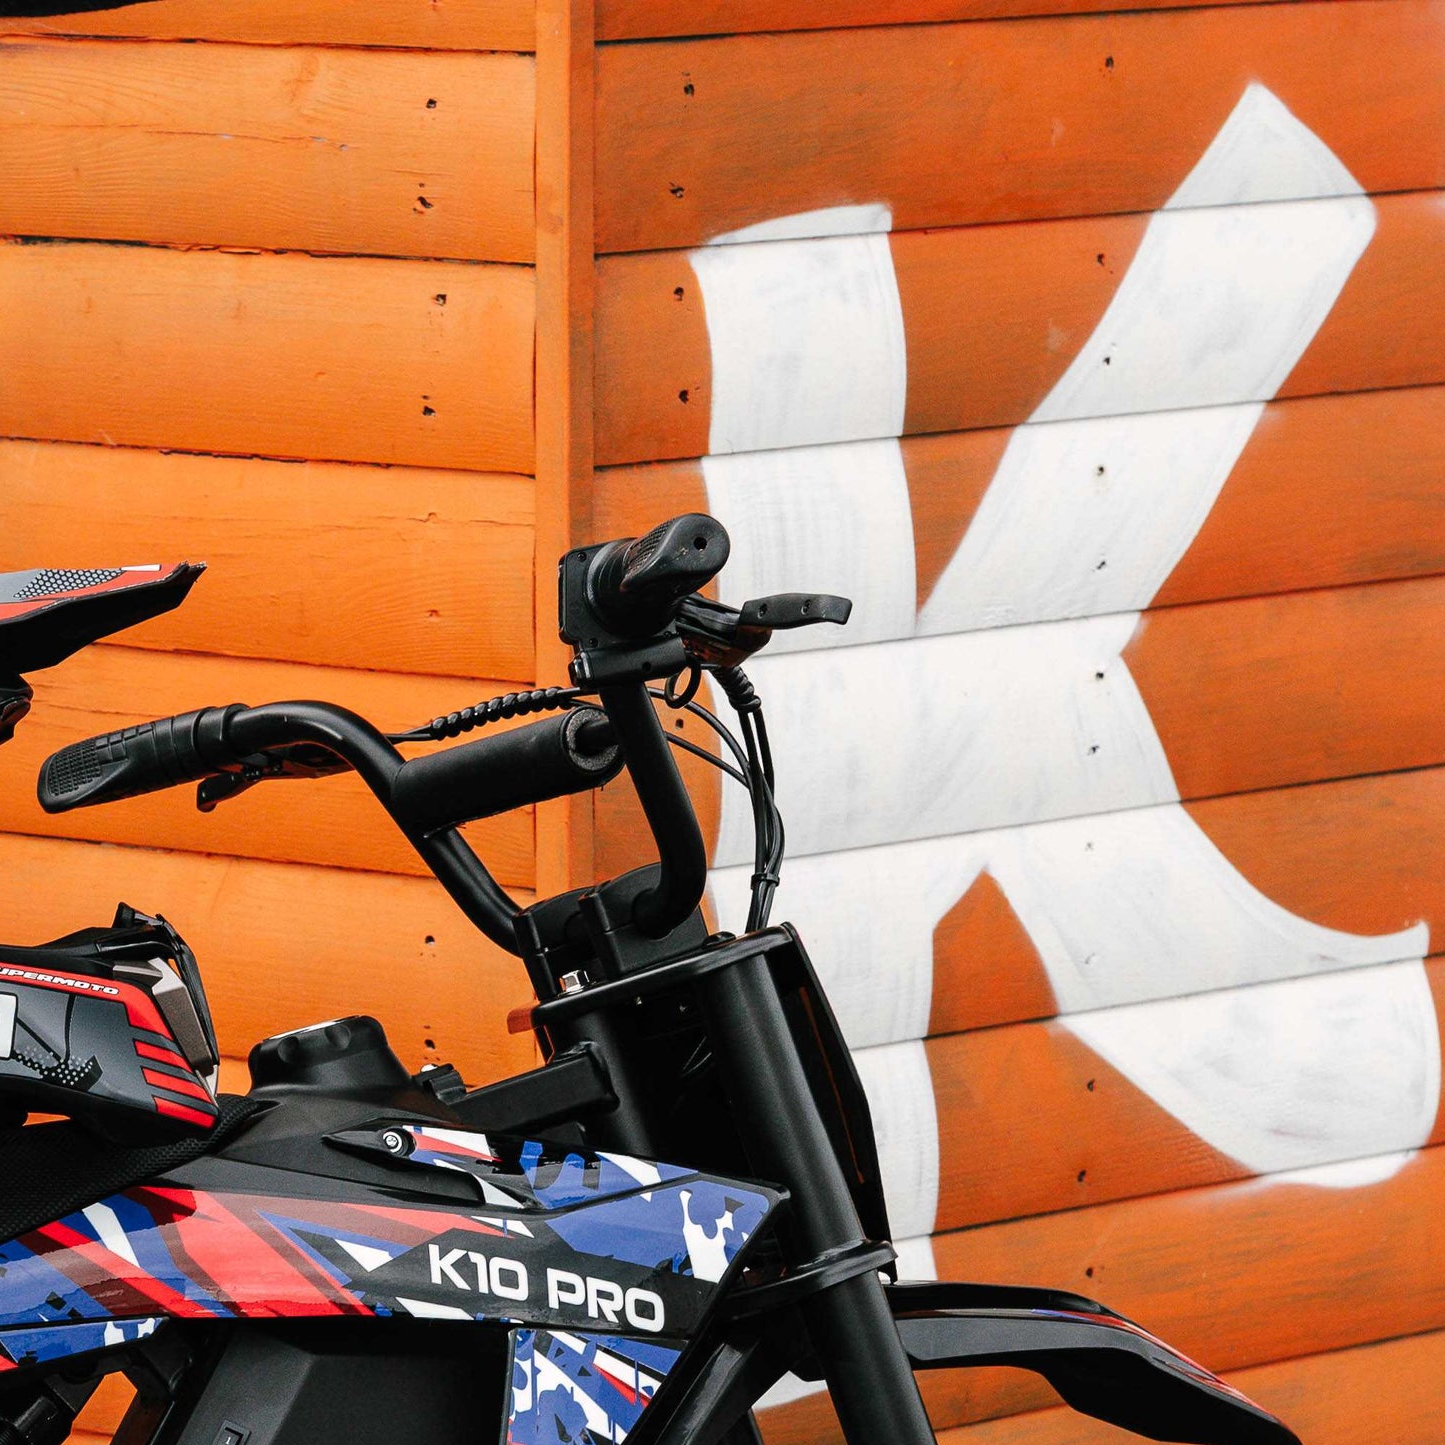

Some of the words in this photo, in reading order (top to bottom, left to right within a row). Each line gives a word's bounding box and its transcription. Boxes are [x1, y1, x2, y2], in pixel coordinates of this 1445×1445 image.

[689, 82, 1441, 1410] K
[428, 1243, 530, 1302] K10
[546, 1267, 666, 1333] PRO
[225, 1436, 231, 1445] 1
